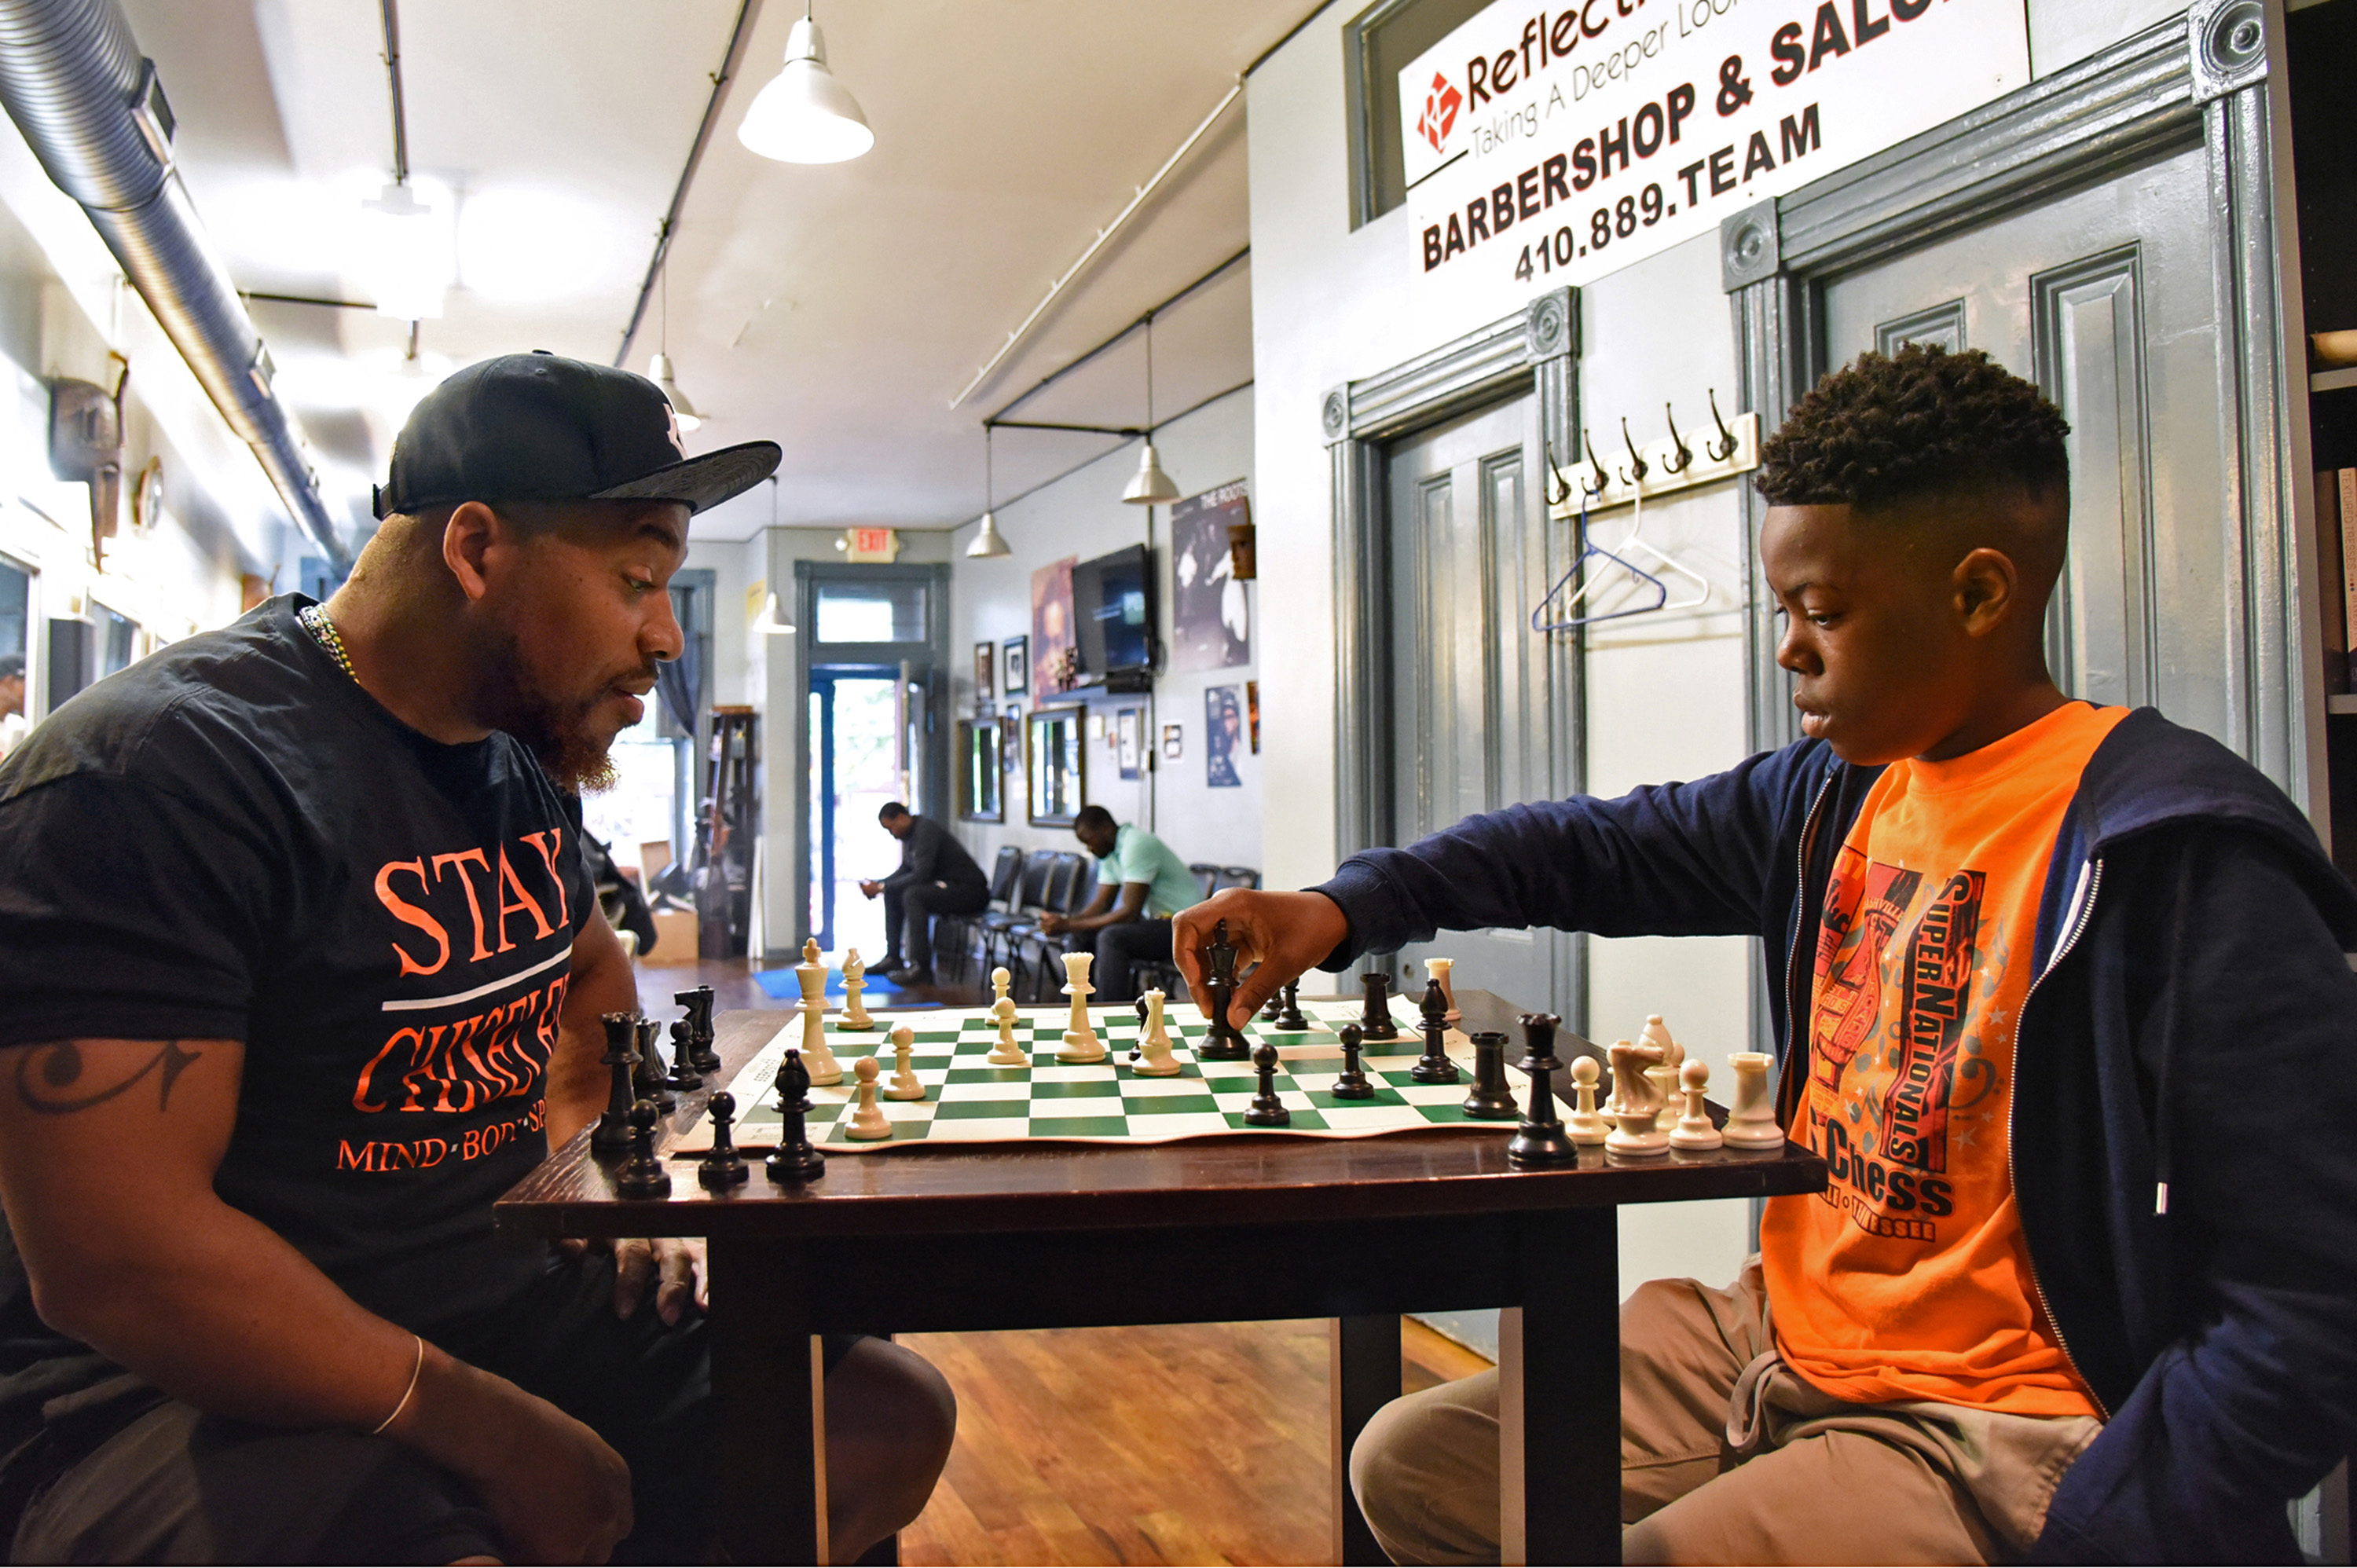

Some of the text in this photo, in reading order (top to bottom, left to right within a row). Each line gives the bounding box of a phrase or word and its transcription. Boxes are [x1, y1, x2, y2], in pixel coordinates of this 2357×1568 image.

[1468, 0, 1644, 114] Reflec
[1471, 0, 1737, 159] Taking A Deeper Loo
[1424, 0, 1952, 273] BARBERSHOP & SAL
[1515, 102, 1822, 283] 410.889.TEAM
[857, 529, 889, 552] EXIT
[2342, 471, 2356, 570] TEXTURED TRESSES
[374, 827, 570, 978] STAY
[335, 1139, 447, 1172] MIND
[462, 1118, 522, 1161] BOD
[1852, 1194, 1936, 1244] TNESSEE
